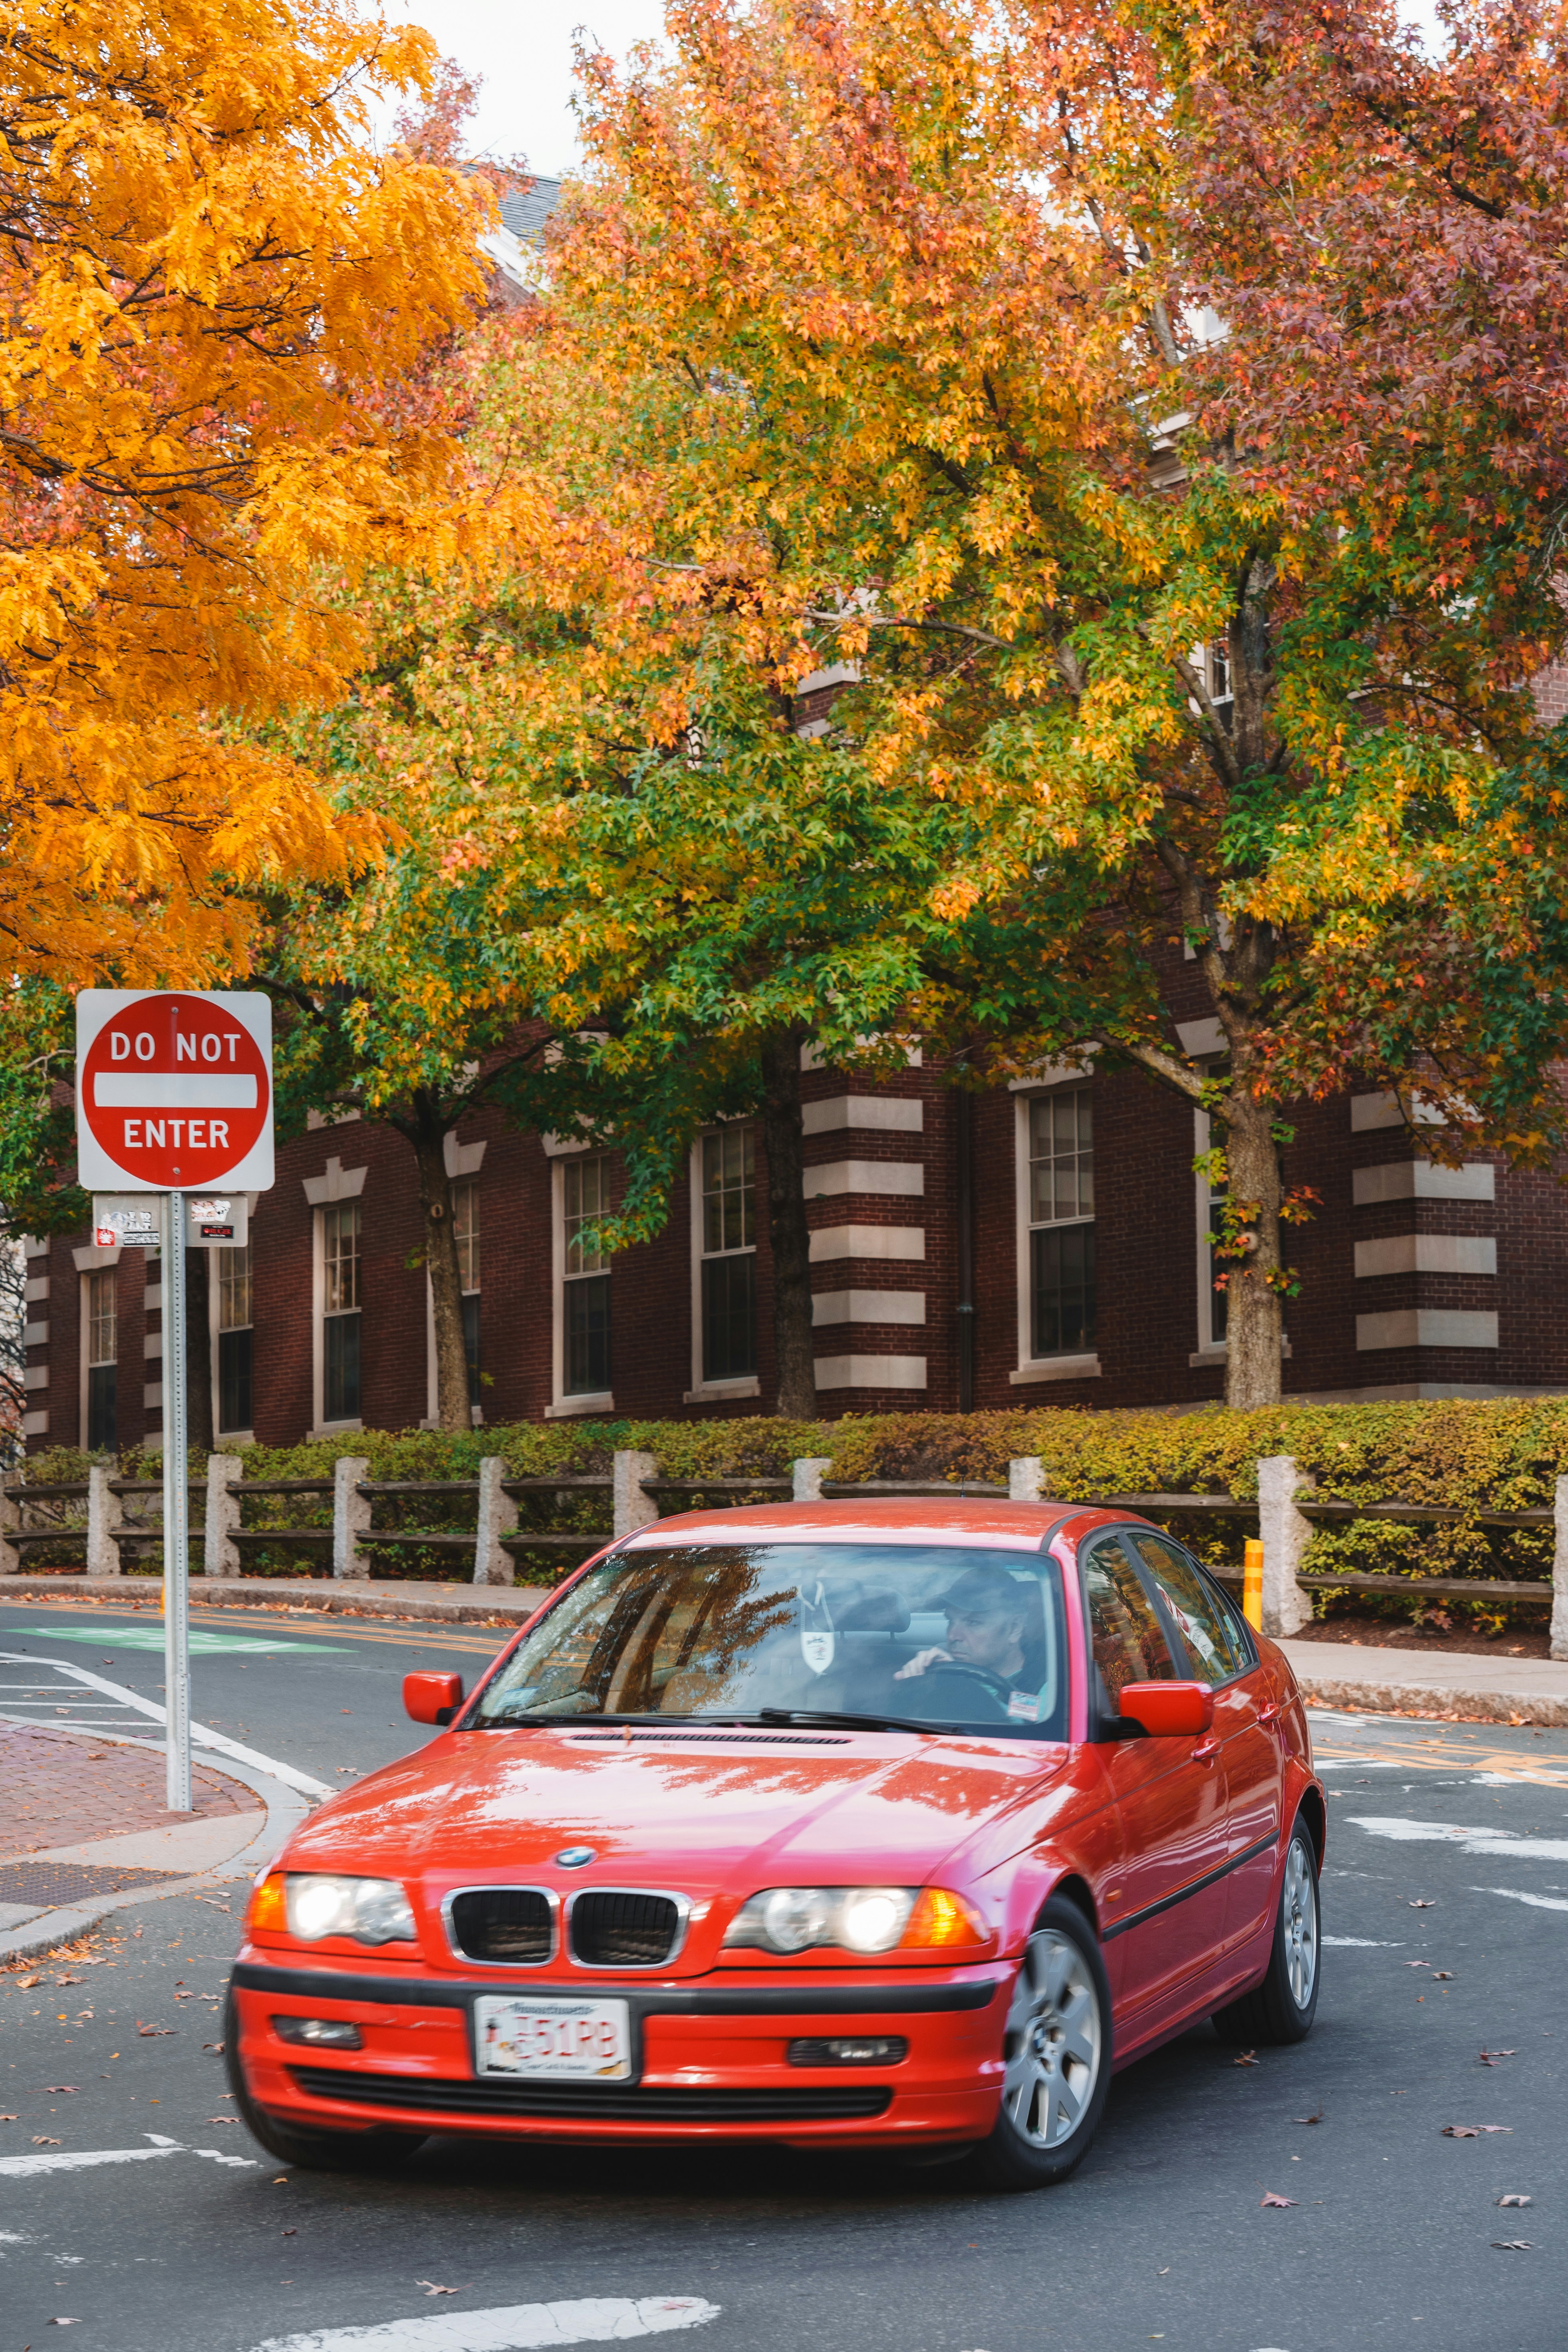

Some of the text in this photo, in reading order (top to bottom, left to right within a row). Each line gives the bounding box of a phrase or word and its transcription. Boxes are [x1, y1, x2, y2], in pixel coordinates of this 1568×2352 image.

[111, 1032, 241, 1062] DO NOT
[124, 1119, 229, 1148] ENTER
